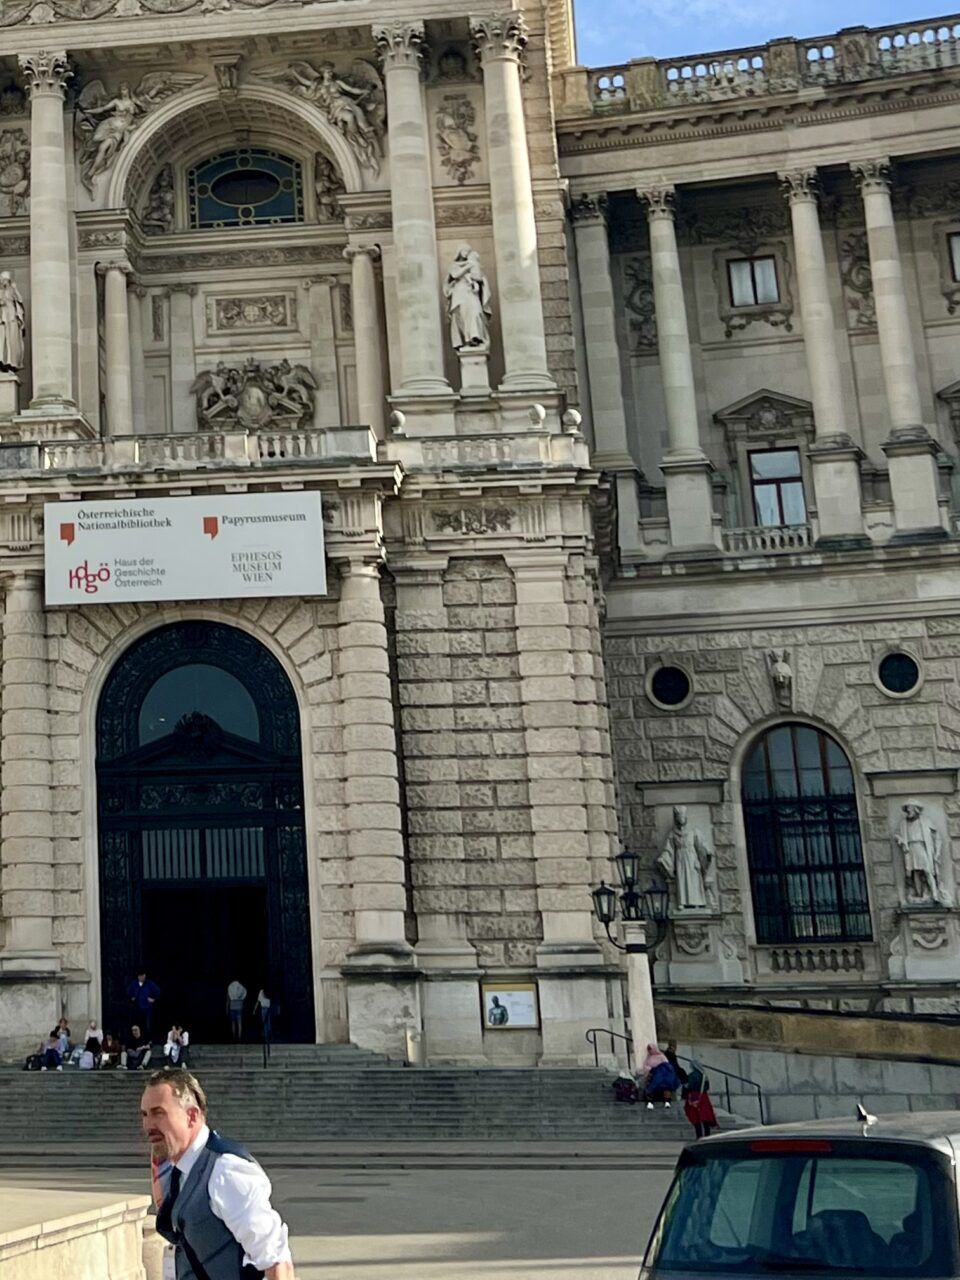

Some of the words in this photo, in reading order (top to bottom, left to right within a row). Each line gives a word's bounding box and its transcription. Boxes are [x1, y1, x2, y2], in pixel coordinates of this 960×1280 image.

[77, 508, 155, 521] Österreichische
[221, 512, 307, 527] Papyrusmuseum
[78, 517, 172, 531] Nationalbibliothek
[114, 558, 137, 567] Haus
[138, 557, 154, 566] der
[231, 551, 283, 563] EPHESOS
[114, 567, 166, 578] Geschichte
[232, 561, 283, 573] MUSEUM
[114, 576, 163, 588] Österreich
[242, 572, 274, 583] WIEN
